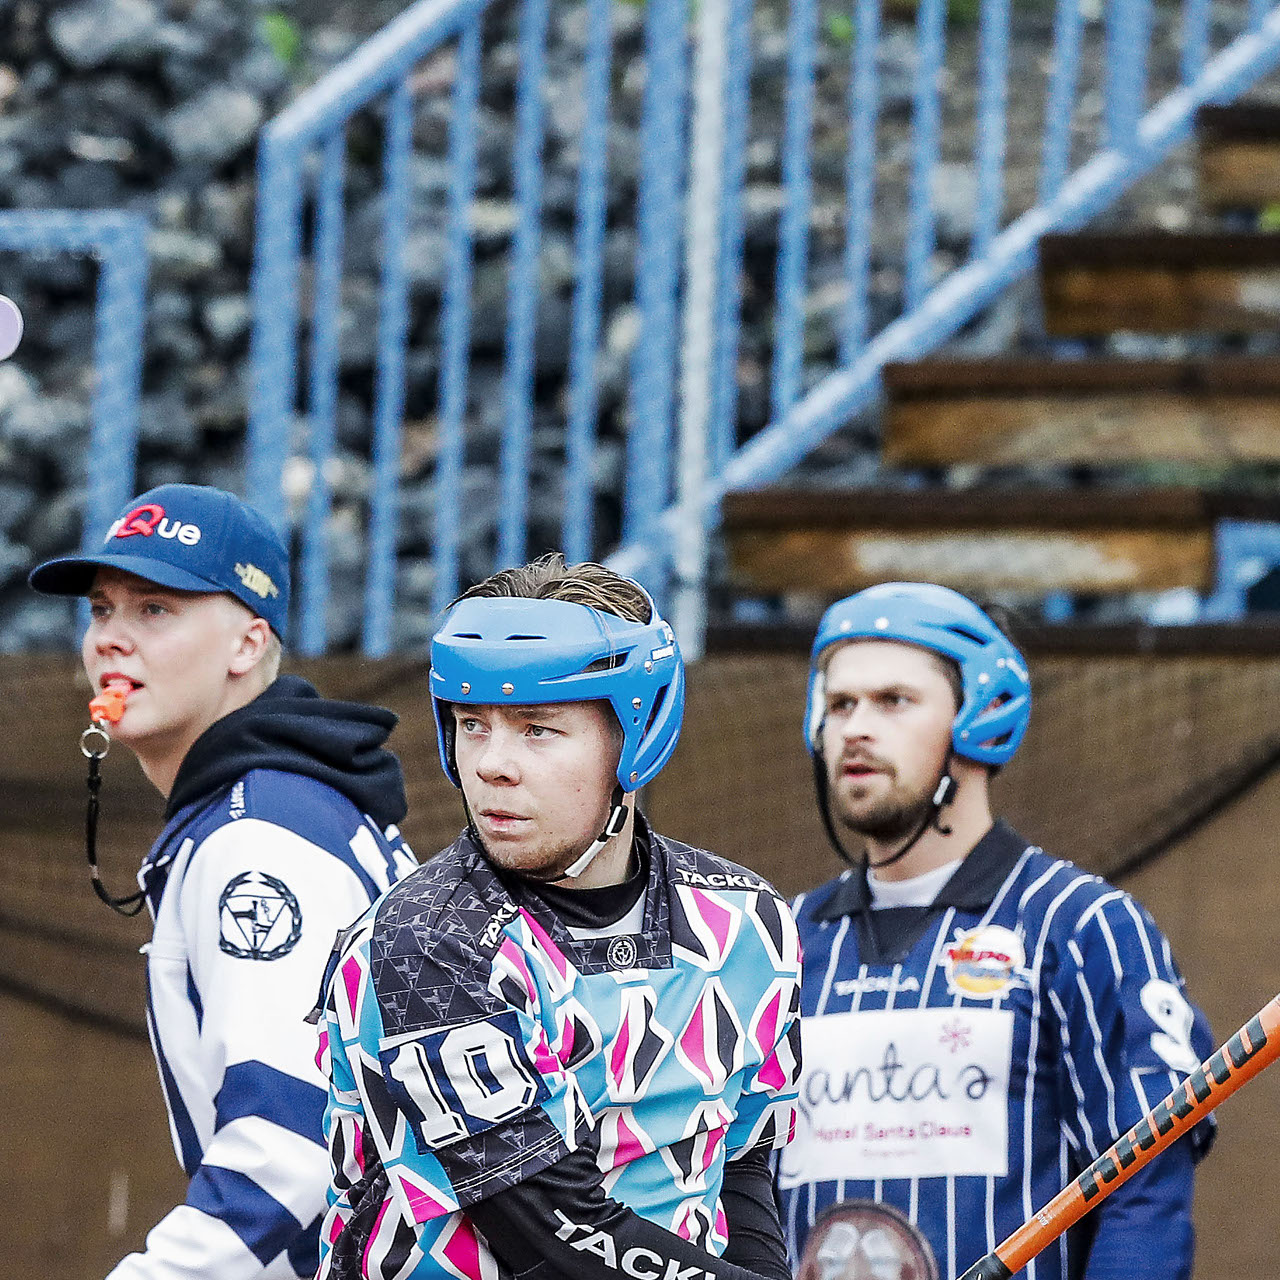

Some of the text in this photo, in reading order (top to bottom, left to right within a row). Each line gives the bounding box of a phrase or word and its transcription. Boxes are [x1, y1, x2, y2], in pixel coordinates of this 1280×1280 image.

[675, 867, 778, 897] TACKLA
[1139, 979, 1201, 1076] 9
[389, 1020, 539, 1150] 10
[1077, 1015, 1269, 1202] KARHU
